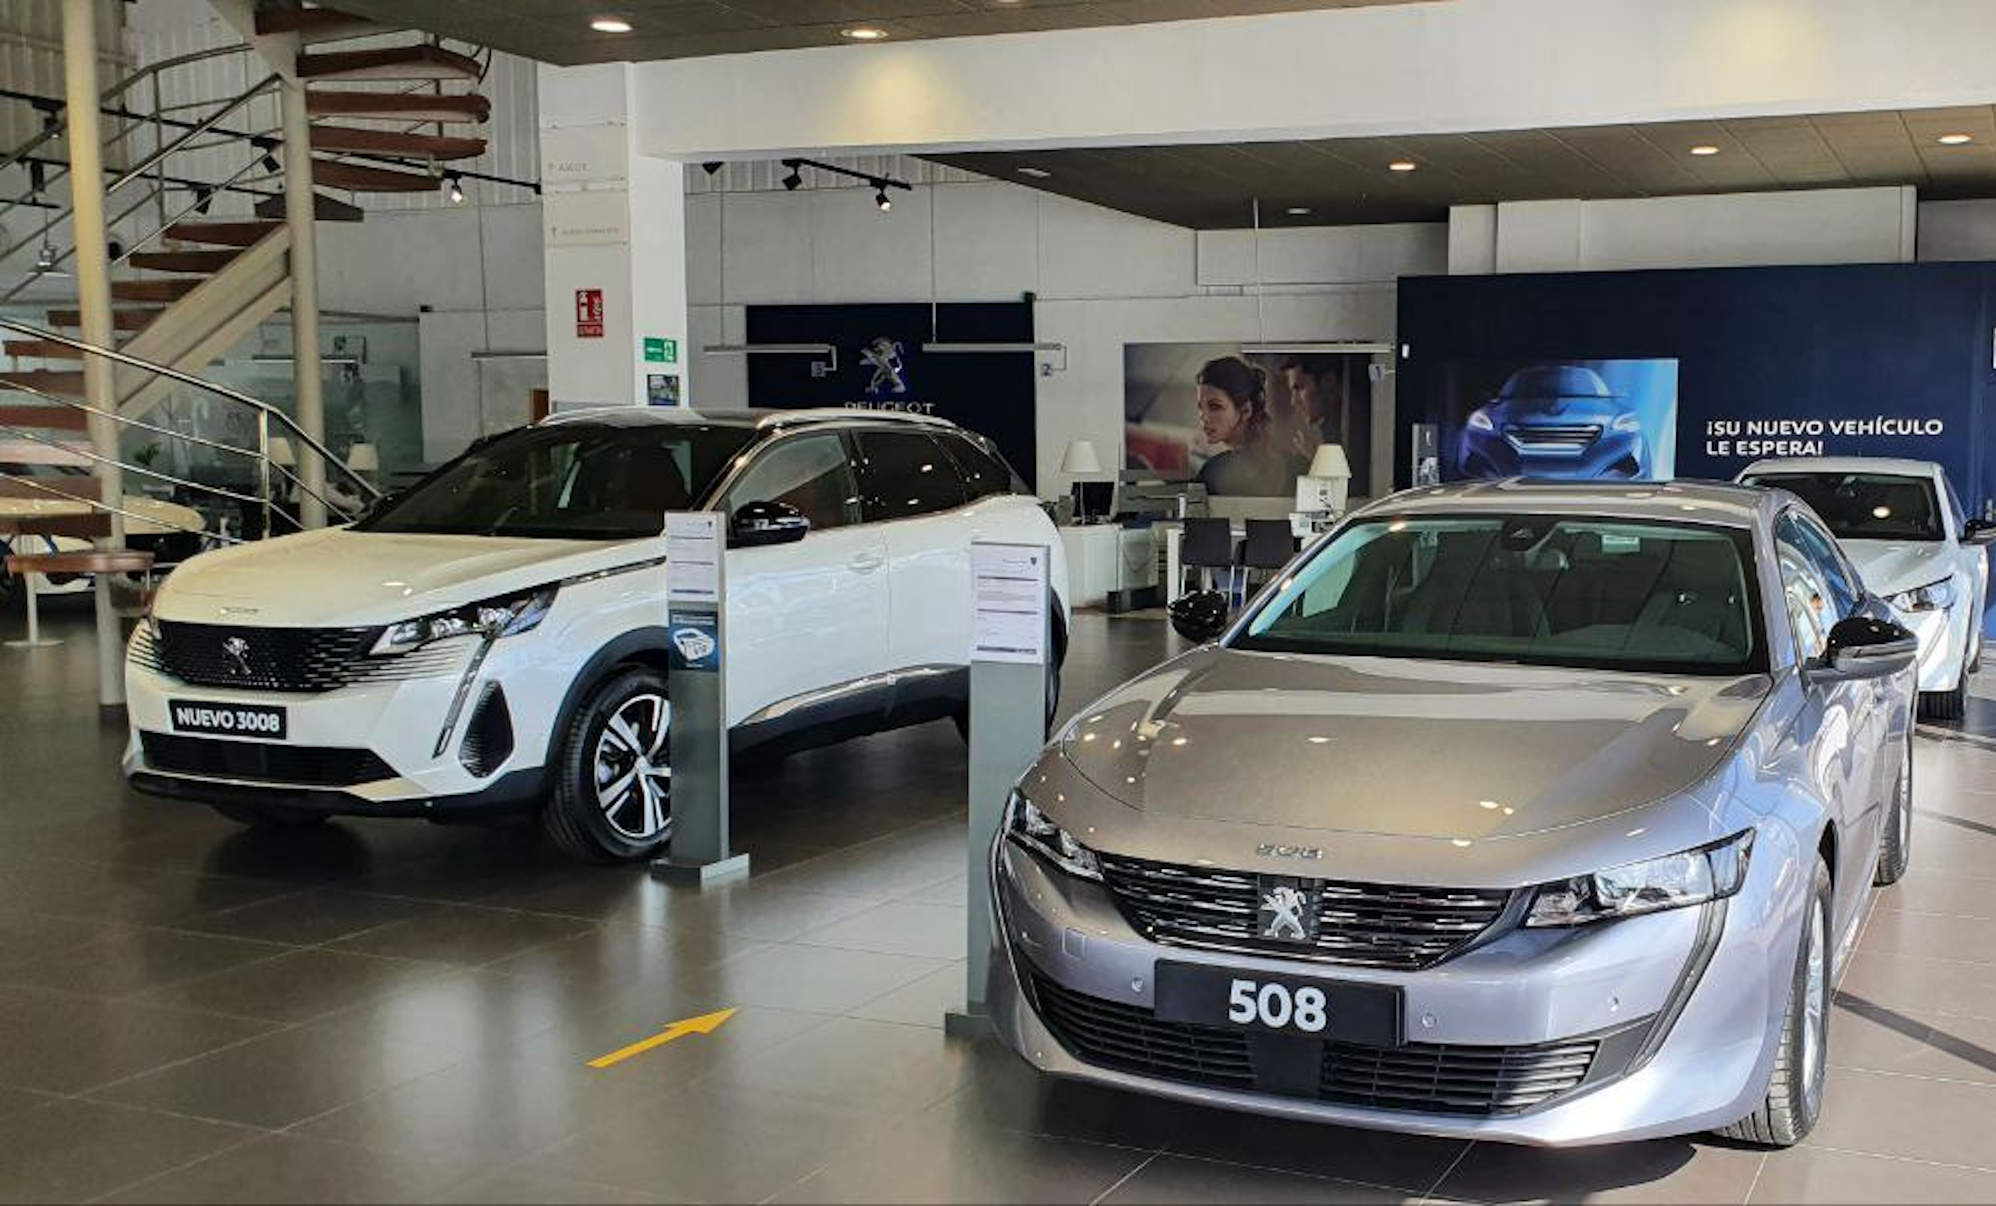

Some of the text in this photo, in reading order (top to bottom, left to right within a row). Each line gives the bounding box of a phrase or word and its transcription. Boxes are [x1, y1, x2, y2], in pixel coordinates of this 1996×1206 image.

[844, 401, 936, 414] PEUGEOT
[1706, 416, 1944, 436] ¡SU NUEVO VEHÍCULO
[1706, 440, 1824, 456] LE ESPERA!
[175, 707, 280, 732] NUEVO 3008
[1228, 979, 1328, 1032] 508
